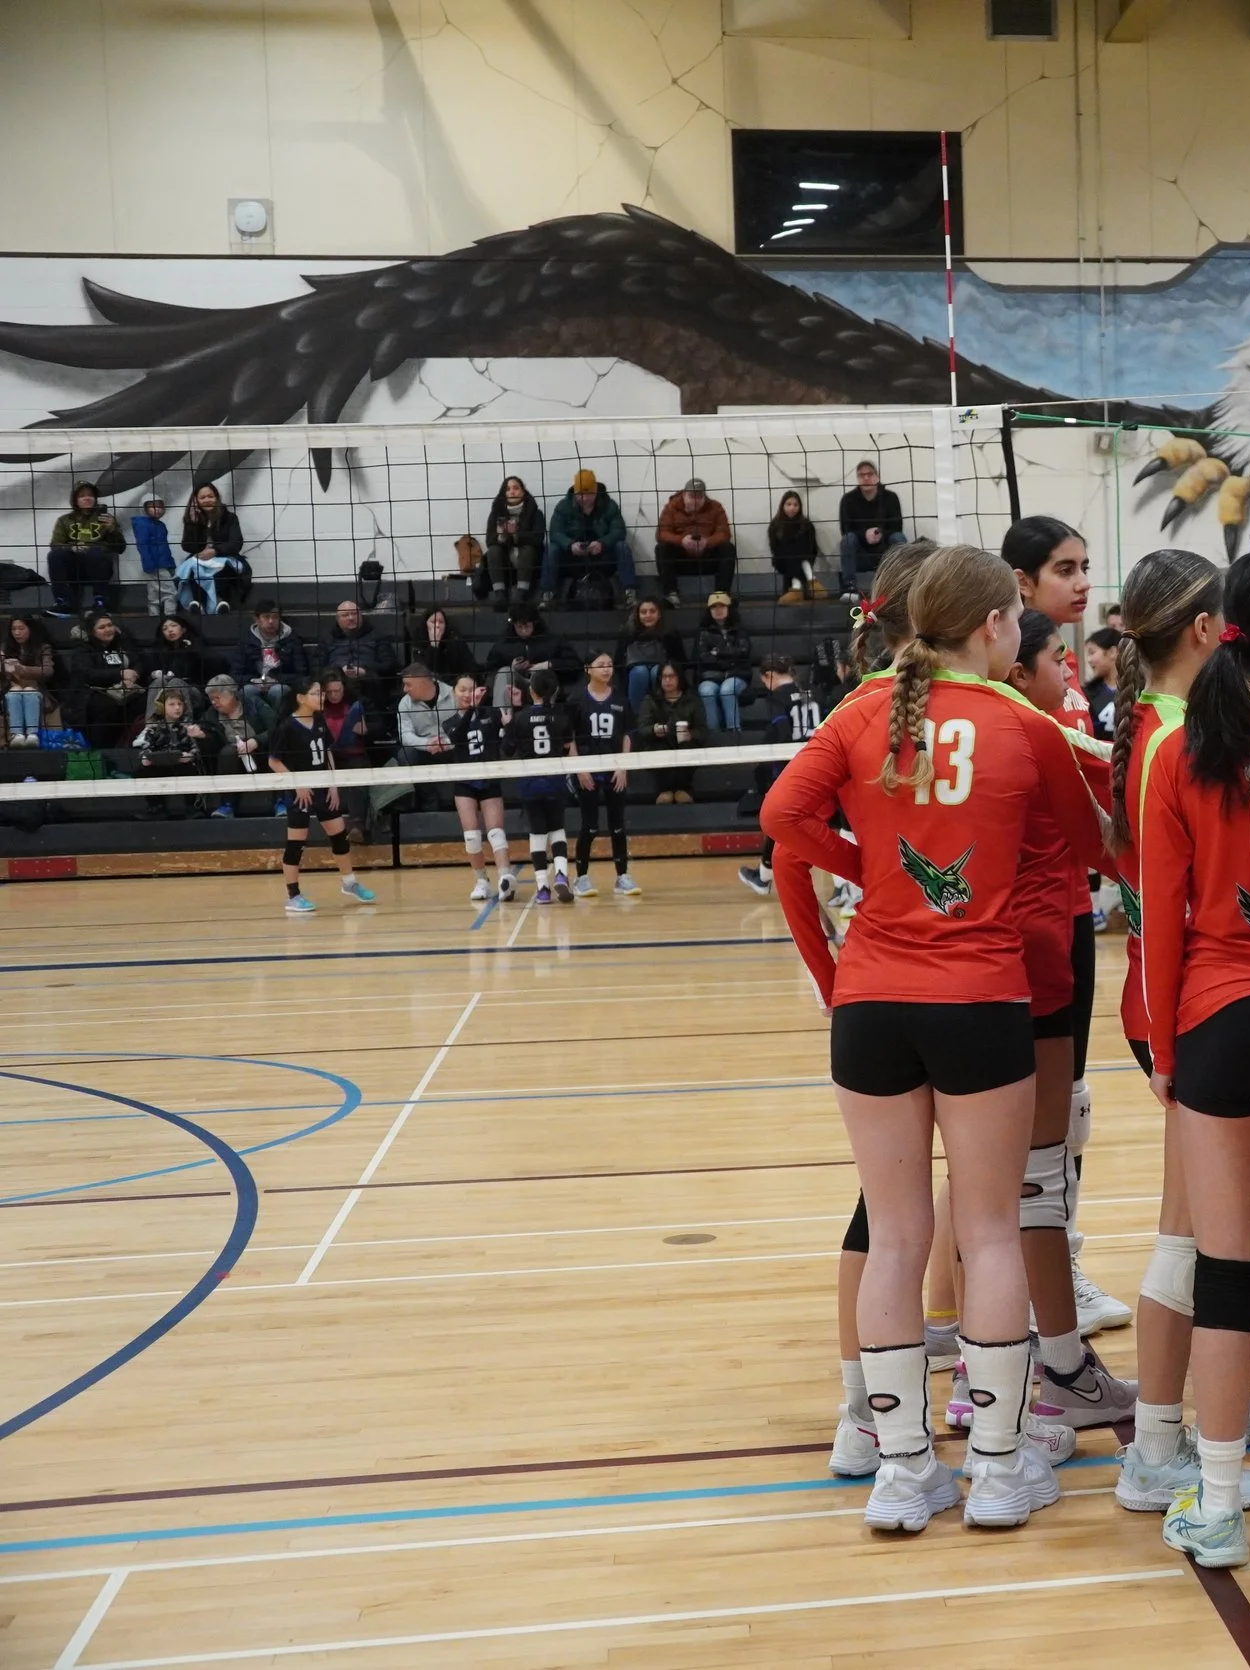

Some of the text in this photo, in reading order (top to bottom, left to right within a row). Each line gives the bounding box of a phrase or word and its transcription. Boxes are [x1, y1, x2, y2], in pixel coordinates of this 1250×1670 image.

[589, 712, 614, 739] 19
[466, 729, 484, 756] 2
[533, 725, 551, 755] 8
